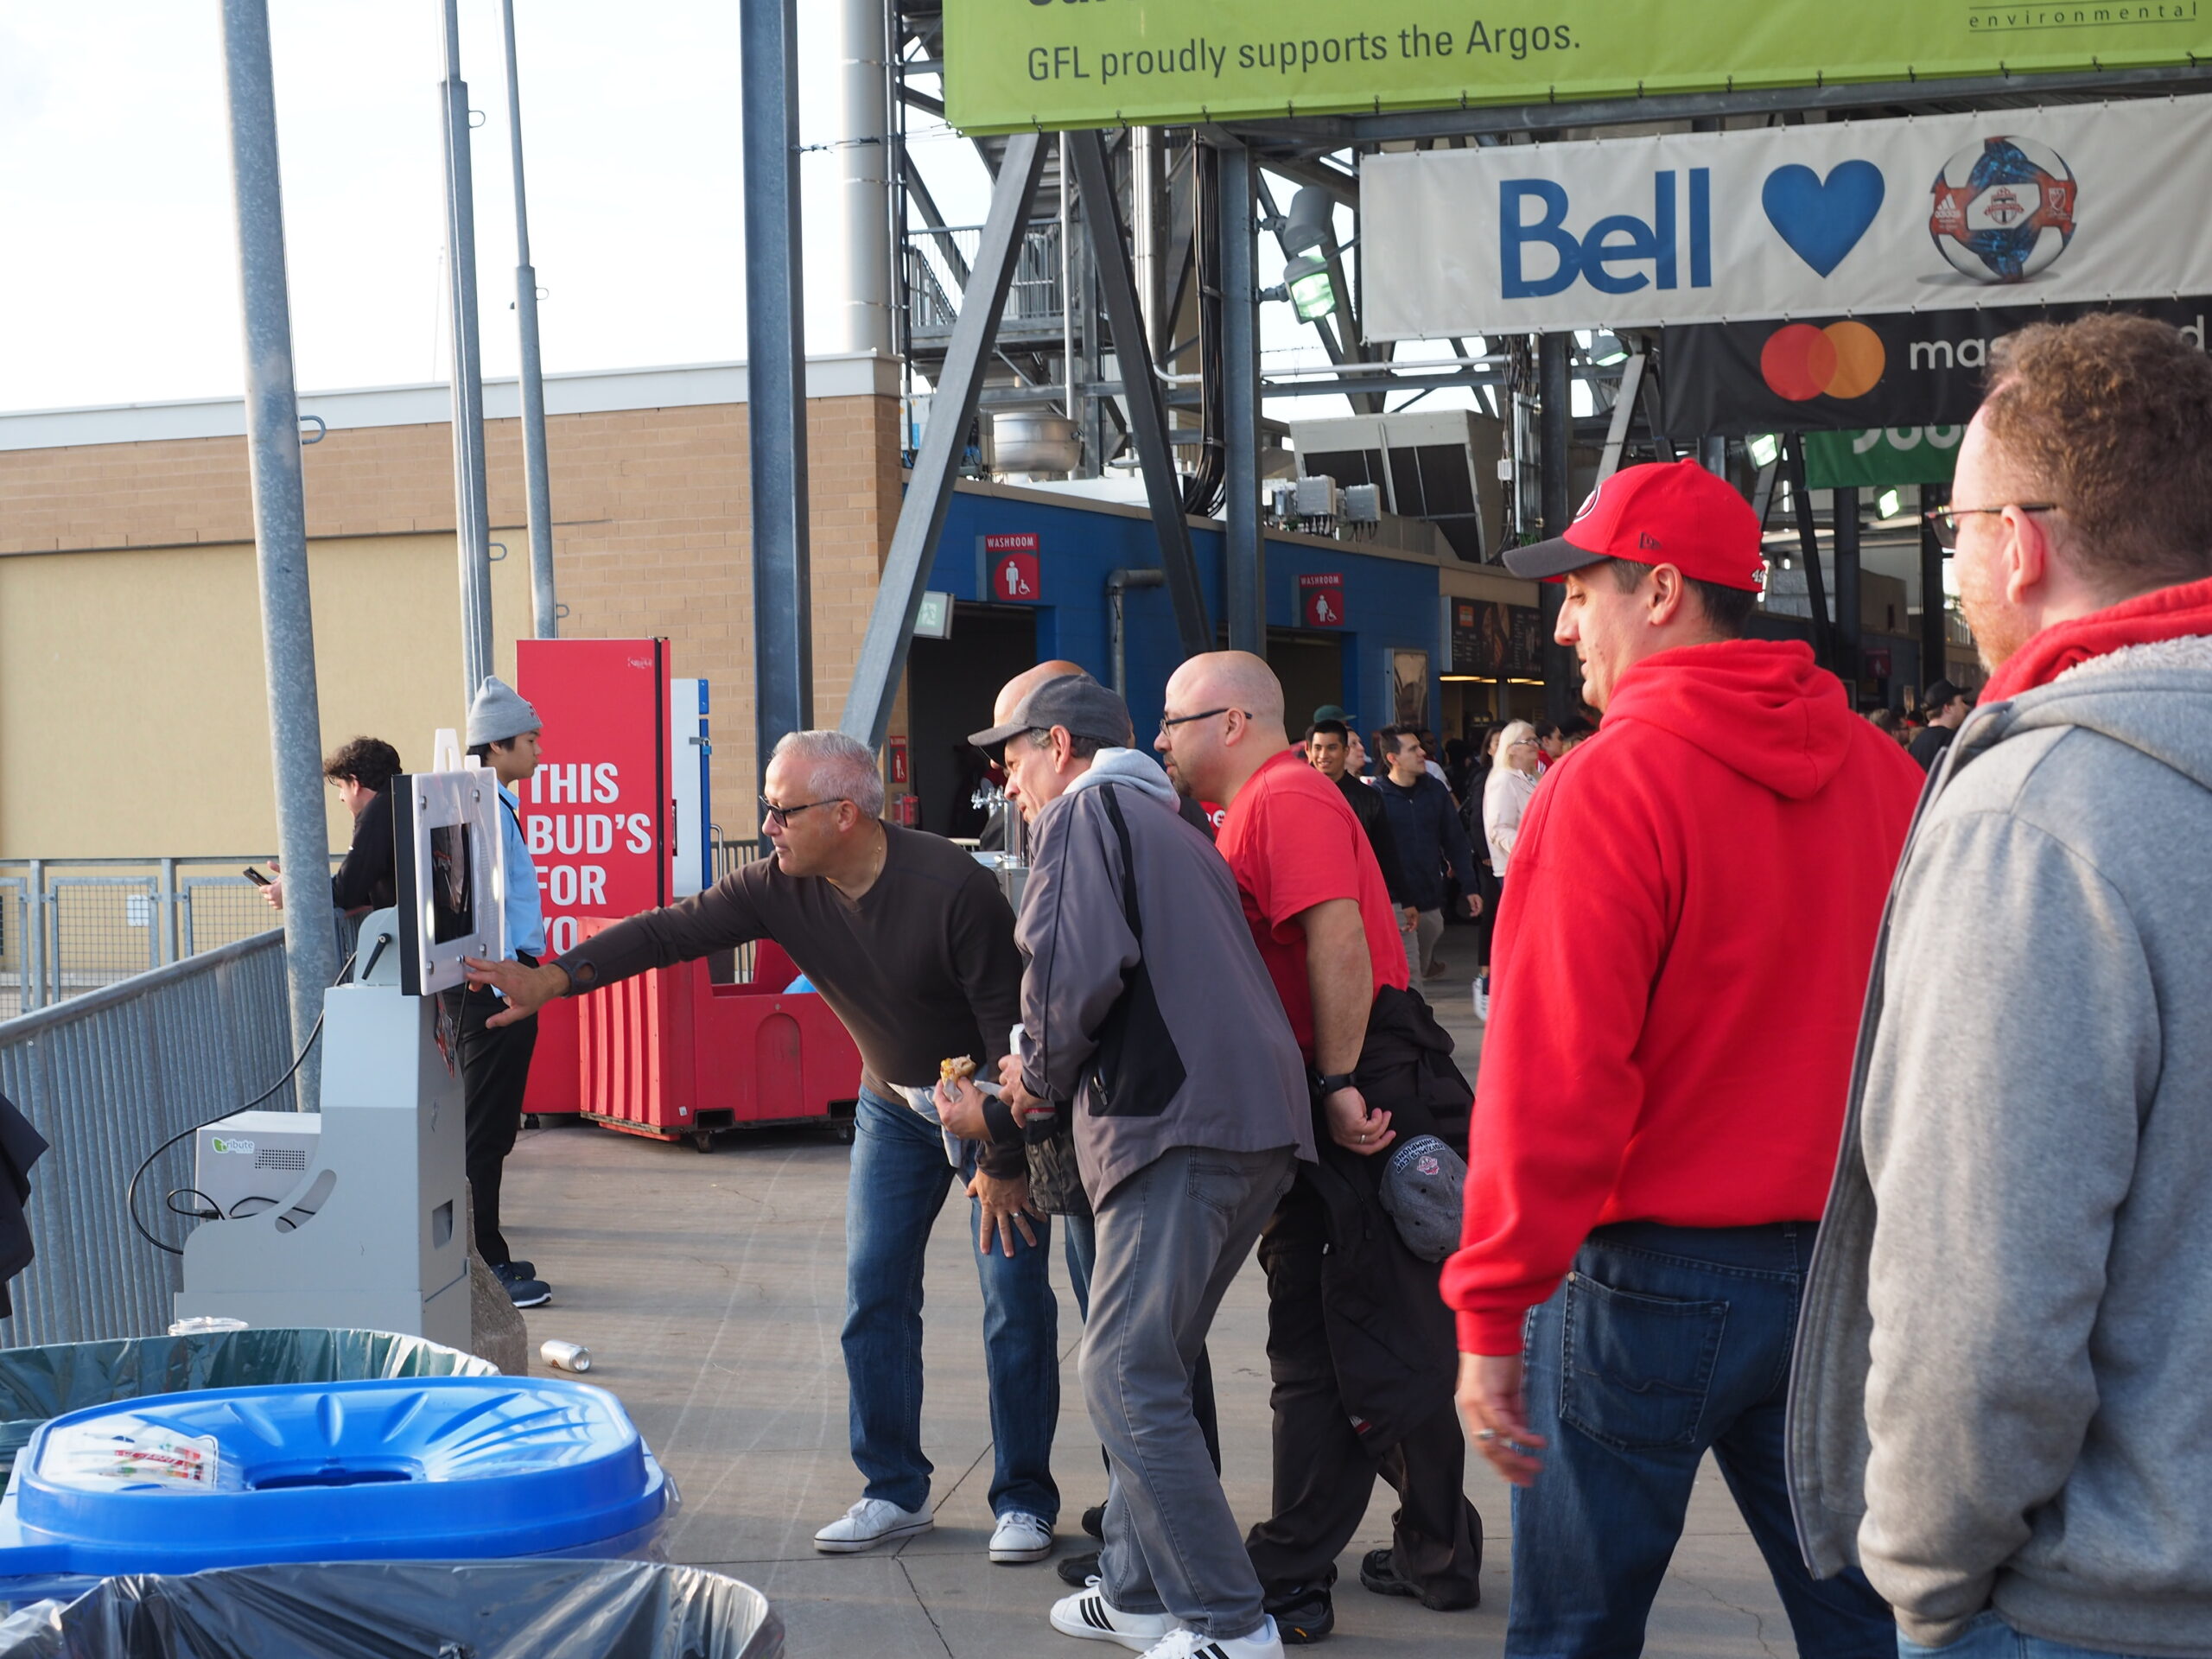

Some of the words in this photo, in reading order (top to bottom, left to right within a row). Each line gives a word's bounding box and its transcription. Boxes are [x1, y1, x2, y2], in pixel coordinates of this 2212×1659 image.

[1968, 1, 2196, 28] environmental
[1028, 46, 1090, 80] GFL
[1102, 38, 1226, 85] proudly
[1238, 31, 1388, 74] supports
[1397, 23, 1453, 58] the
[1465, 20, 1580, 60] Argos.
[1500, 167, 1712, 299] Bell
[987, 537, 1034, 548] WASHROOM
[1300, 575, 1339, 585] WASHROOM
[531, 762, 620, 804] THIS
[527, 813, 652, 855] BUD’S
[1394, 1138, 1438, 1165] CHAMPIONS
[1396, 1157, 1410, 1173] CUP
[1410, 1147, 1428, 1160] MLS
